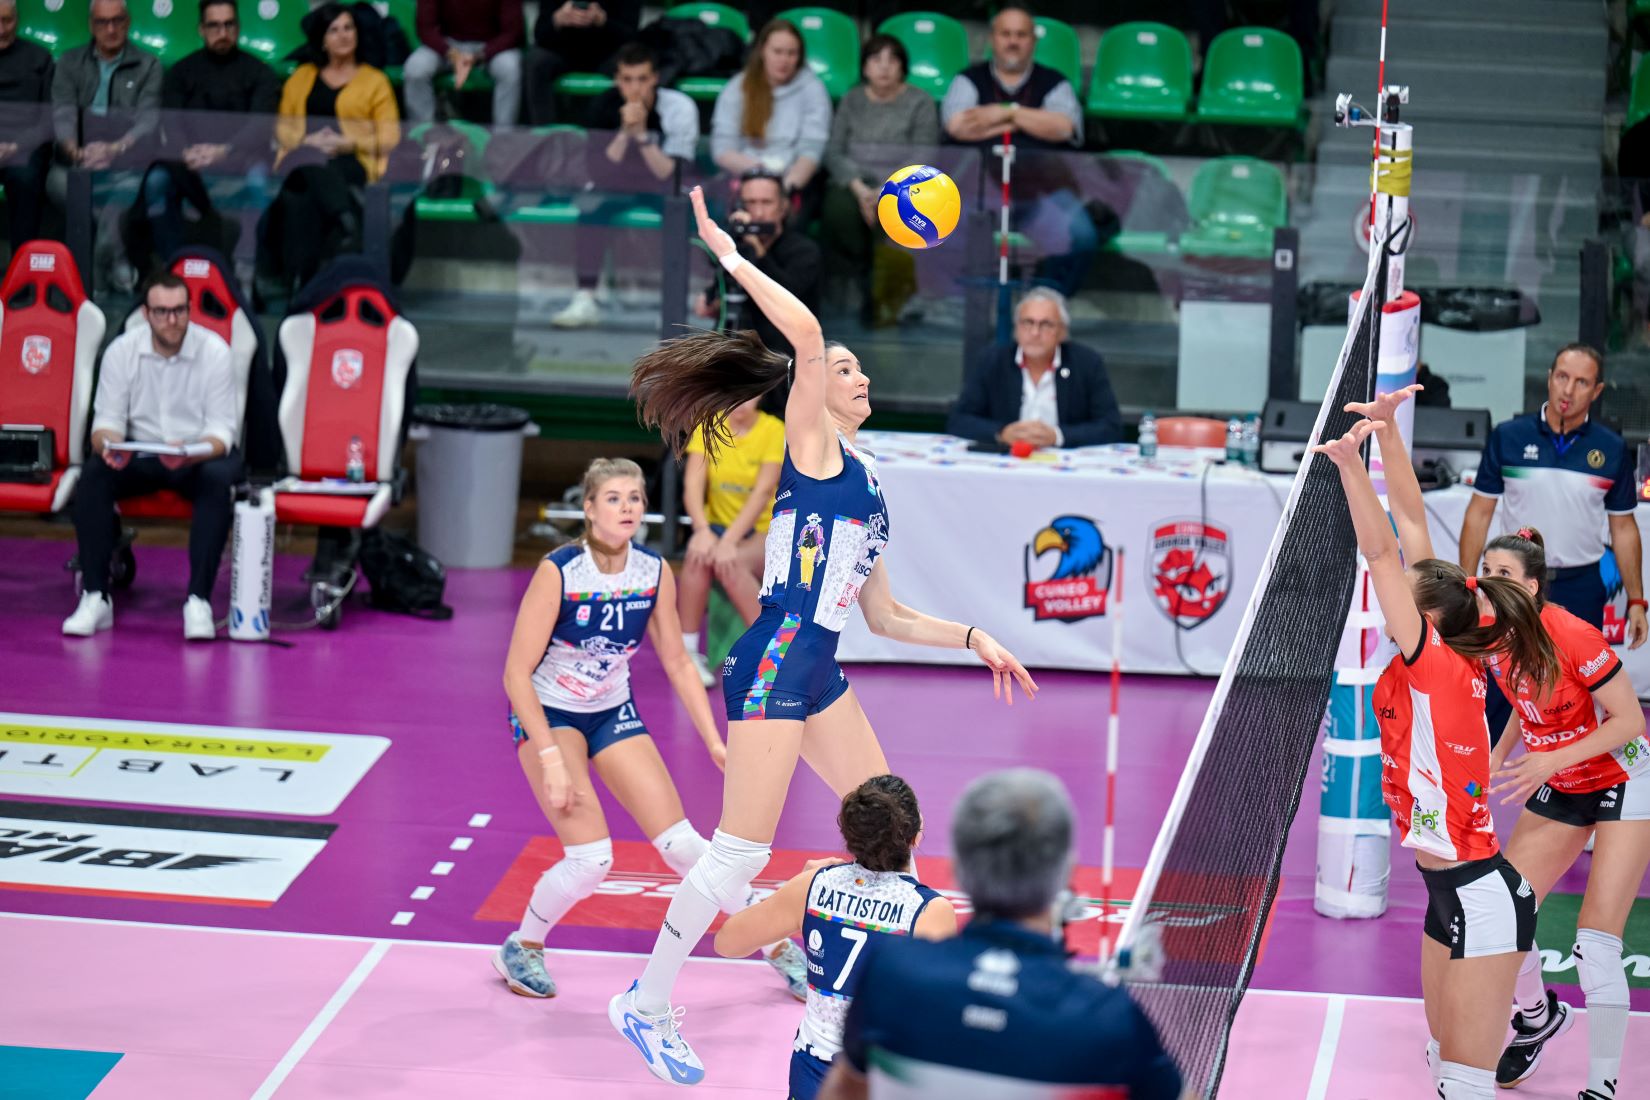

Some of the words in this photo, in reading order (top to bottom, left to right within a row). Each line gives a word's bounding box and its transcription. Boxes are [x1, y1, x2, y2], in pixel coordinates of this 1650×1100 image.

[911, 214, 927, 227] FIVB
[1034, 582, 1089, 599] CUNEO
[1043, 595, 1102, 613] VOLLEY
[600, 602, 624, 631] 21
[618, 702, 637, 721] 21
[1517, 699, 1547, 725] 10
[6, 729, 314, 757] LABORATORIO
[1536, 784, 1552, 804] 10
[832, 927, 868, 990] 7
